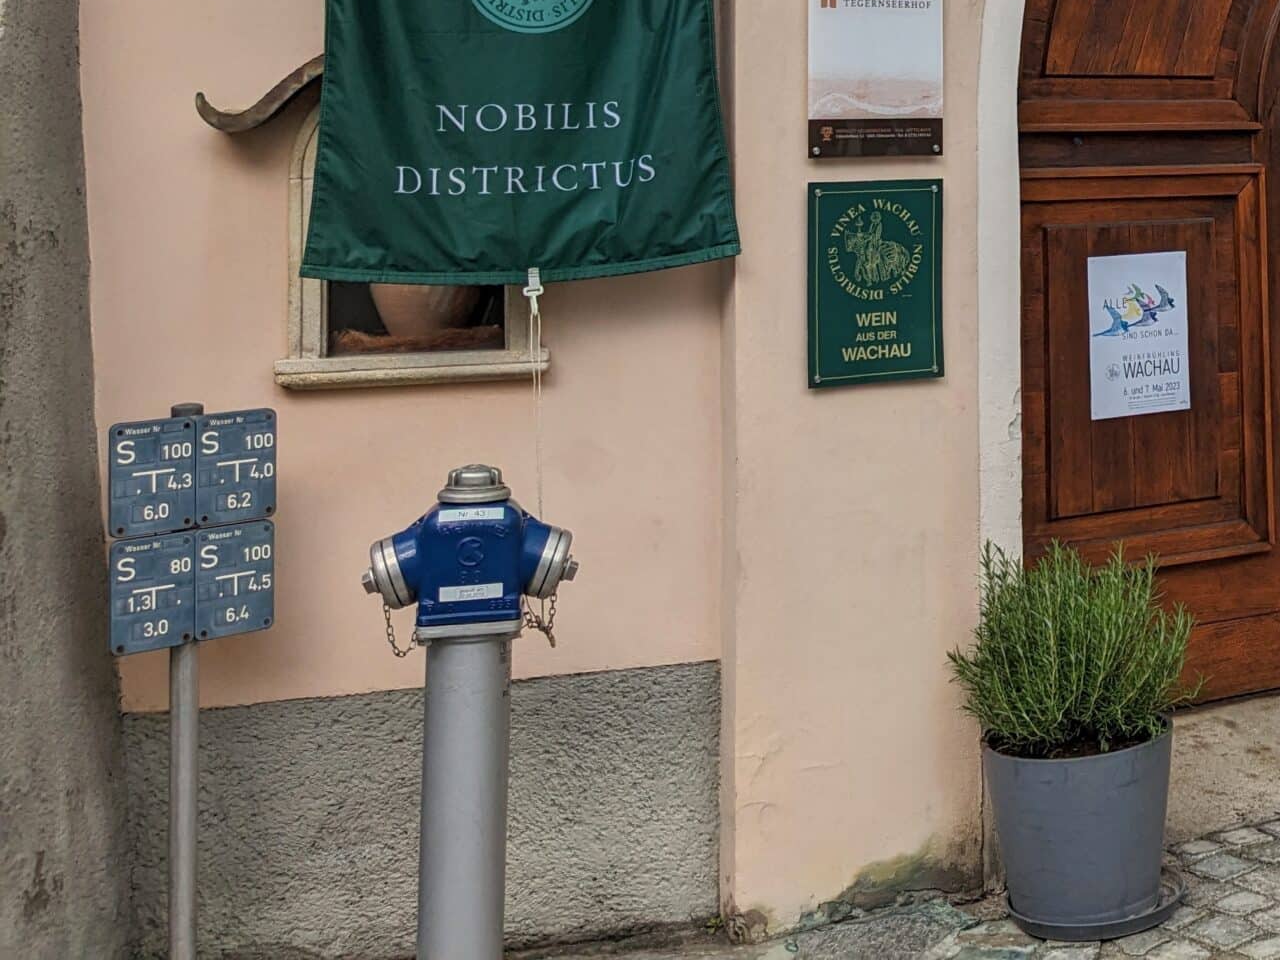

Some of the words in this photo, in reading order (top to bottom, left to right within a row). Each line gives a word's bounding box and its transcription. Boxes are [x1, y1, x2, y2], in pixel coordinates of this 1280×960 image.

[436, 101, 622, 132] NOBILIS
[394, 154, 656, 196] DISTRICTUS
[831, 203, 866, 238] VINEA
[873, 198, 921, 237] WACHAU
[827, 247, 884, 300] DISTRICTUS
[890, 243, 924, 295] NOBILIS
[1103, 297, 1128, 310] ALLE
[856, 311, 897, 327] WEIN
[856, 331, 875, 342] AUS
[877, 330, 896, 340] DER
[1122, 331, 1138, 340] SIND
[1140, 329, 1162, 339] SCHON
[842, 343, 912, 361] WACHAU
[1123, 358, 1180, 379] WACHAU
[1131, 386, 1144, 395] und
[1152, 383, 1164, 392] Mai
[1165, 381, 1180, 392] 2023
[125, 427, 150, 435] Wasser
[153, 425, 161, 433] Nr
[209, 418, 234, 426] Wasser
[117, 441, 135, 464] S
[163, 442, 192, 460] 100
[202, 431, 219, 454] S
[245, 433, 274, 450] 100
[208, 531, 233, 540] Wasser
[125, 543, 150, 552] Wasser
[200, 545, 219, 568] S
[244, 544, 271, 562] 100
[117, 557, 136, 581] S
[170, 557, 191, 574] 80
